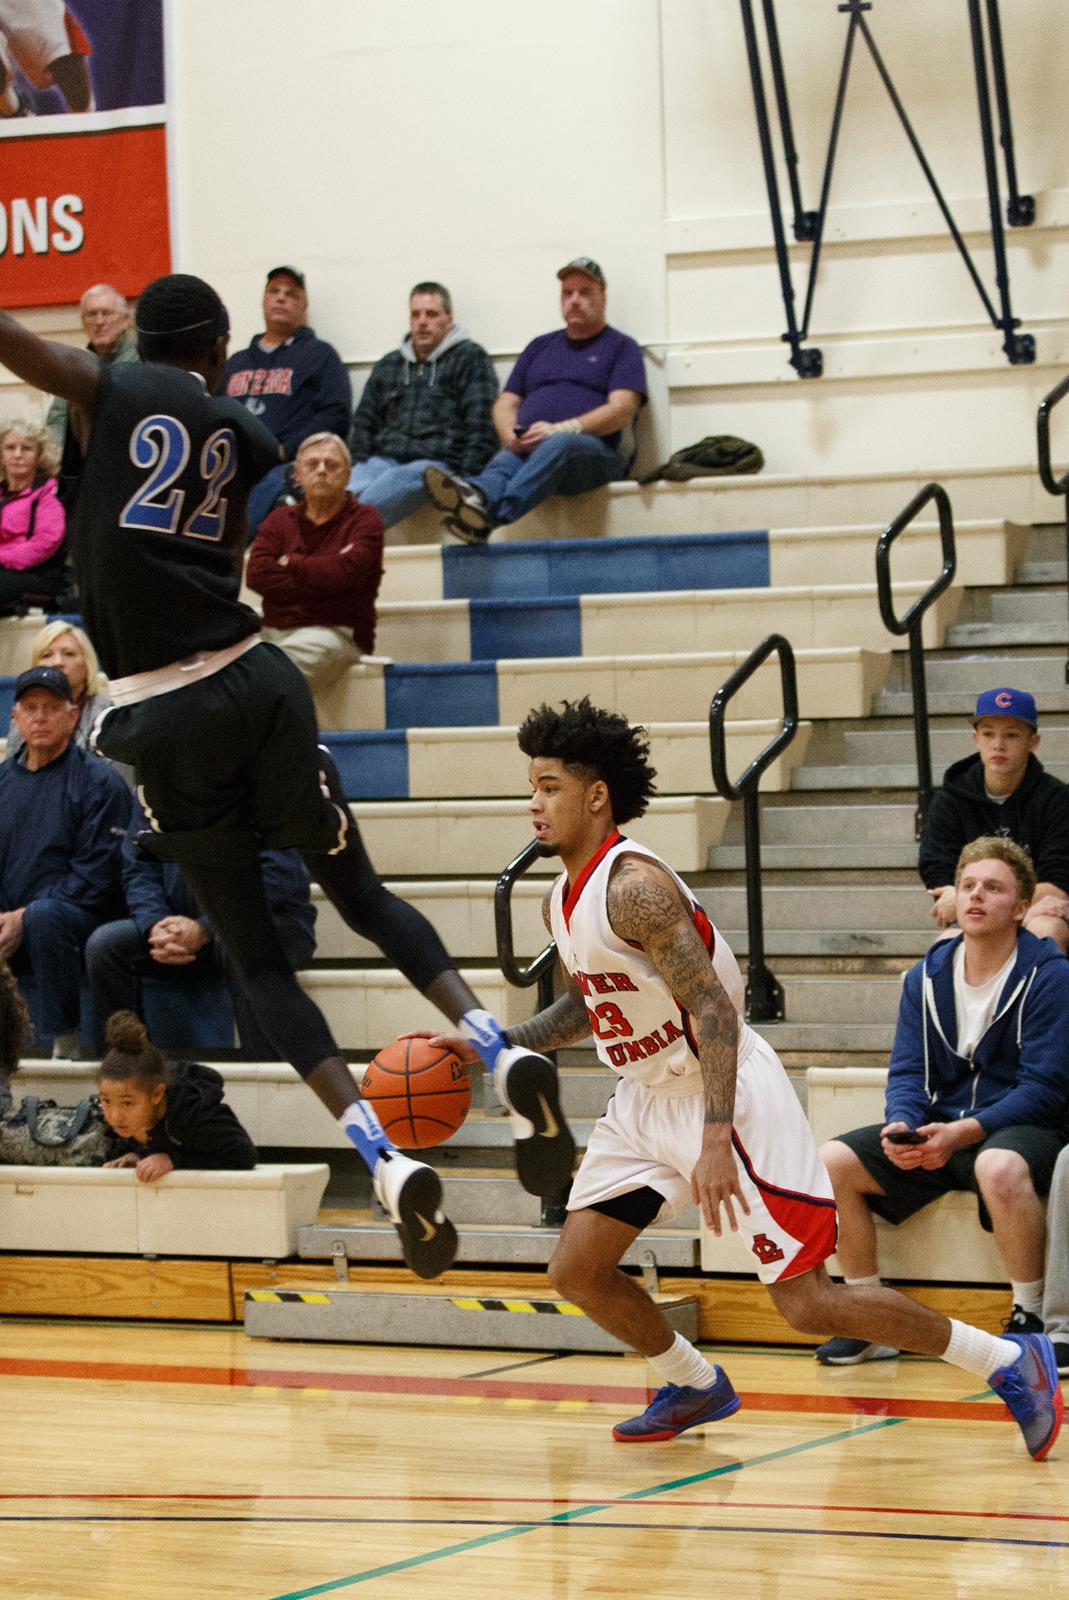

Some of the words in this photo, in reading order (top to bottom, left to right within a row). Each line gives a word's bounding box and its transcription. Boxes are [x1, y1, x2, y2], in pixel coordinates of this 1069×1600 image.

[0, 194, 84, 255] NS
[118, 414, 238, 541] 22
[995, 692, 1012, 709] C
